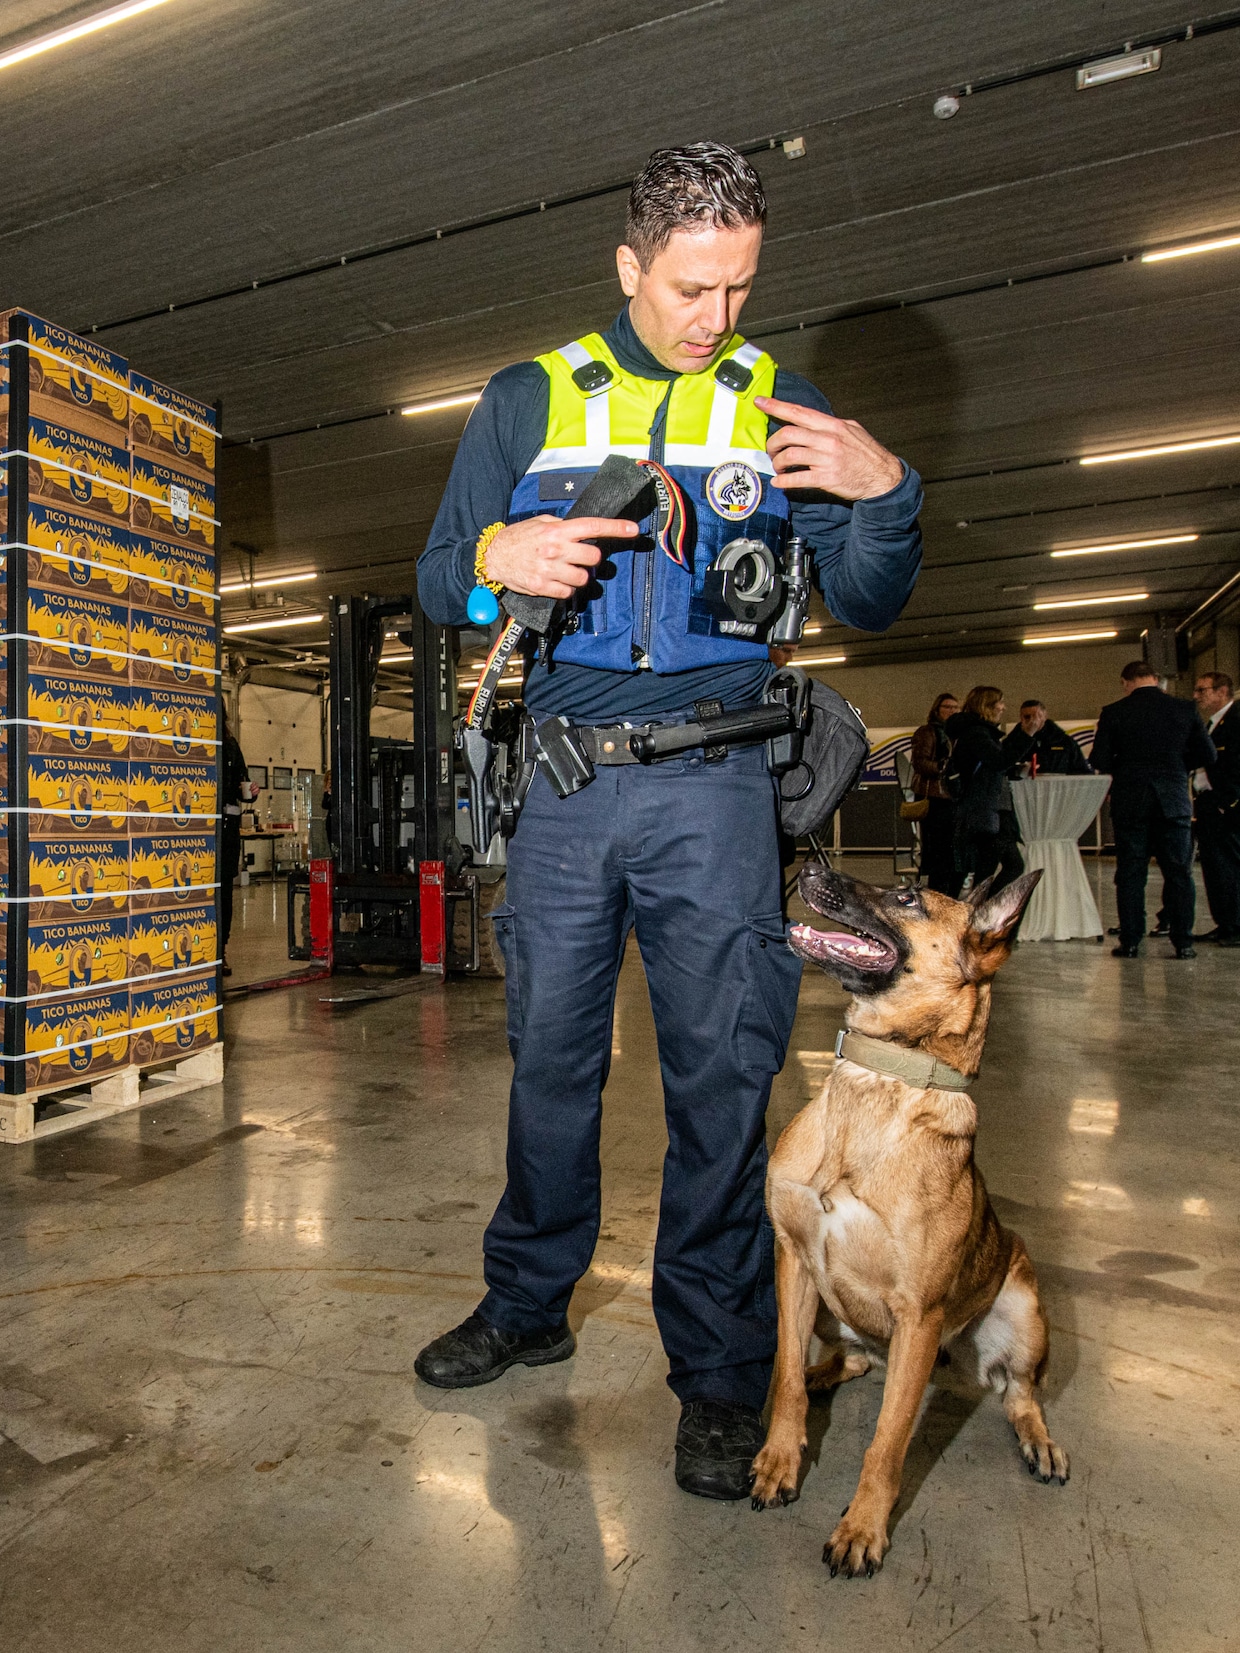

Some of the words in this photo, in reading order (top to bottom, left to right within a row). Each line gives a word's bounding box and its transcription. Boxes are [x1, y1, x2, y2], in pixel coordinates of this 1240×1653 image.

[44, 325, 66, 341] TICO
[68, 336, 111, 363] BANANAS
[75, 390, 88, 401] TICO
[152, 384, 170, 399] TICO
[171, 393, 206, 417] BANANAS
[46, 425, 68, 440] TICO
[70, 433, 112, 457] BANANAS
[152, 465, 170, 479] TICO
[172, 473, 206, 493] BANANAS
[75, 489, 87, 499] TICO
[655, 480, 670, 512] EURO
[45, 509, 67, 524] TICO
[69, 516, 112, 537] BANANAS
[150, 541, 169, 553] TICO
[170, 546, 206, 564] BANANAS
[73, 572, 86, 581] TICO
[43, 593, 66, 606] TICO
[67, 598, 111, 616] BANANAS
[152, 616, 170, 627] TICO
[171, 620, 207, 636] BANANAS
[501, 623, 523, 652] EURO
[74, 654, 87, 662] TICO
[490, 654, 507, 673] JOE
[45, 679, 67, 691] TICO
[69, 682, 113, 697] BANANAS
[151, 692, 170, 702] TICO
[171, 694, 207, 707] BANANAS
[474, 687, 491, 714] EURO
[43, 759, 66, 770] TICO
[68, 761, 111, 773] BANANAS
[150, 765, 169, 775] TICO
[170, 766, 207, 776] BANANAS
[45, 844, 67, 854] TICO
[69, 844, 113, 854] BANANAS
[151, 840, 169, 849] TICO
[170, 838, 206, 848] BANANAS
[151, 914, 169, 925] TICO
[170, 909, 206, 922] BANANAS
[42, 928, 65, 939] TICO
[67, 922, 111, 936] BANANAS
[74, 981, 86, 989] TICO
[153, 990, 172, 1001] TICO
[172, 981, 208, 997] BANANAS
[41, 1006, 65, 1019] TICO
[66, 997, 111, 1014] BANANAS
[74, 1058, 88, 1067] TICO
